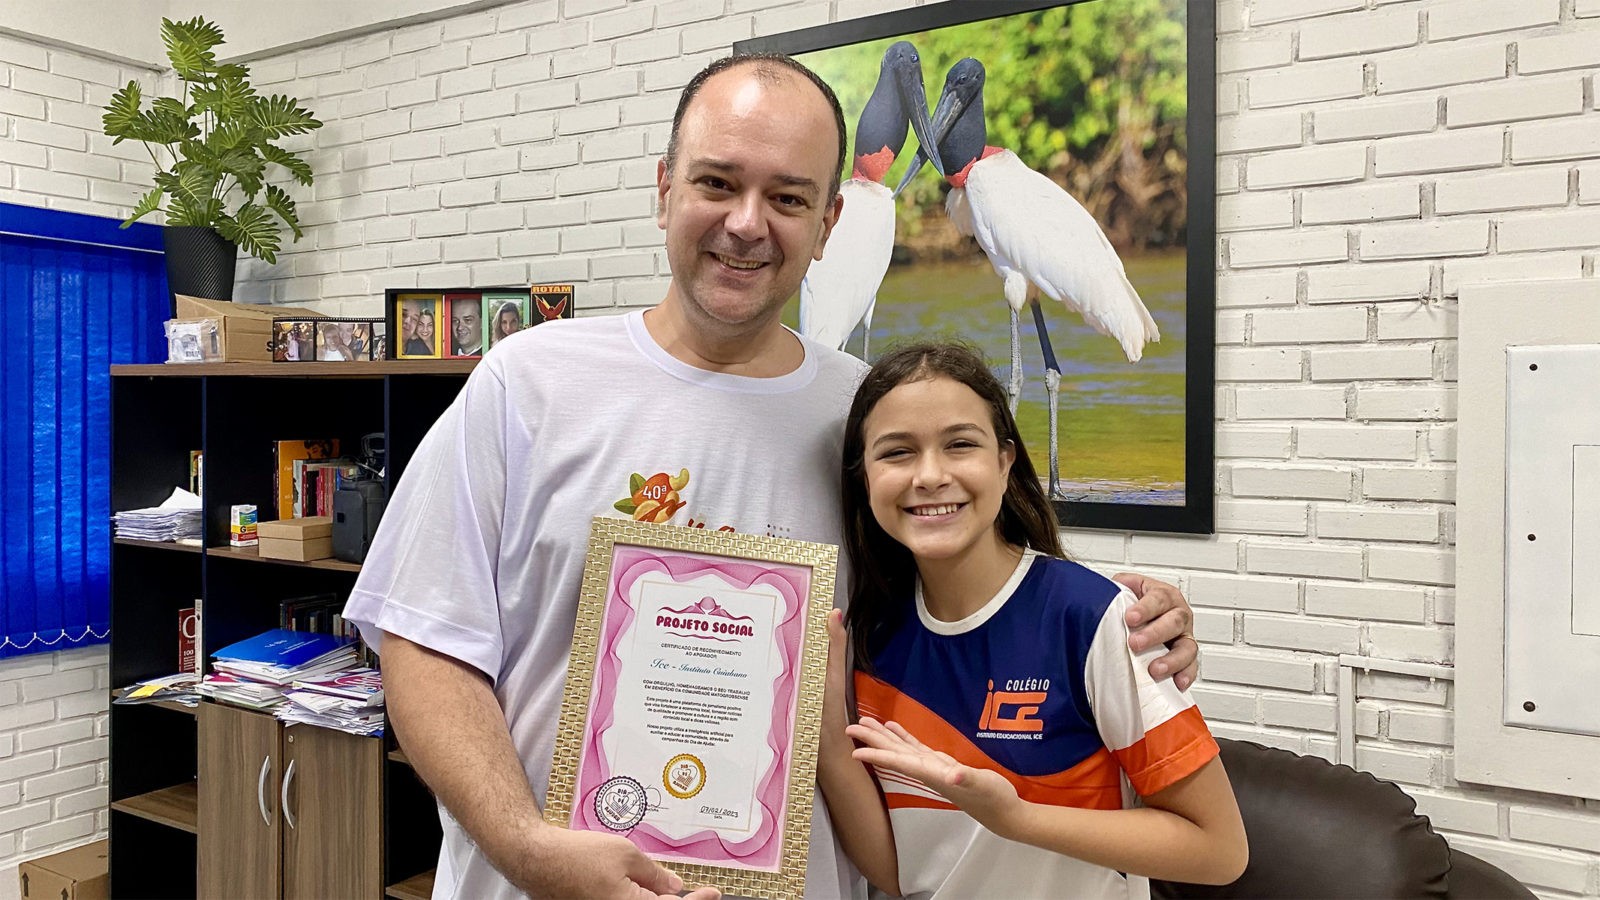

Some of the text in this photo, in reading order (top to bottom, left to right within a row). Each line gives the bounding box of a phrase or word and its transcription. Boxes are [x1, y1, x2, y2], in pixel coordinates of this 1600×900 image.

[656, 616, 754, 636] PROJETO SOCIAL
[700, 647, 742, 656] RECONHECIMENTO
[678, 664, 711, 674] Instituto
[1005, 677, 1050, 691] COLÉGIO
